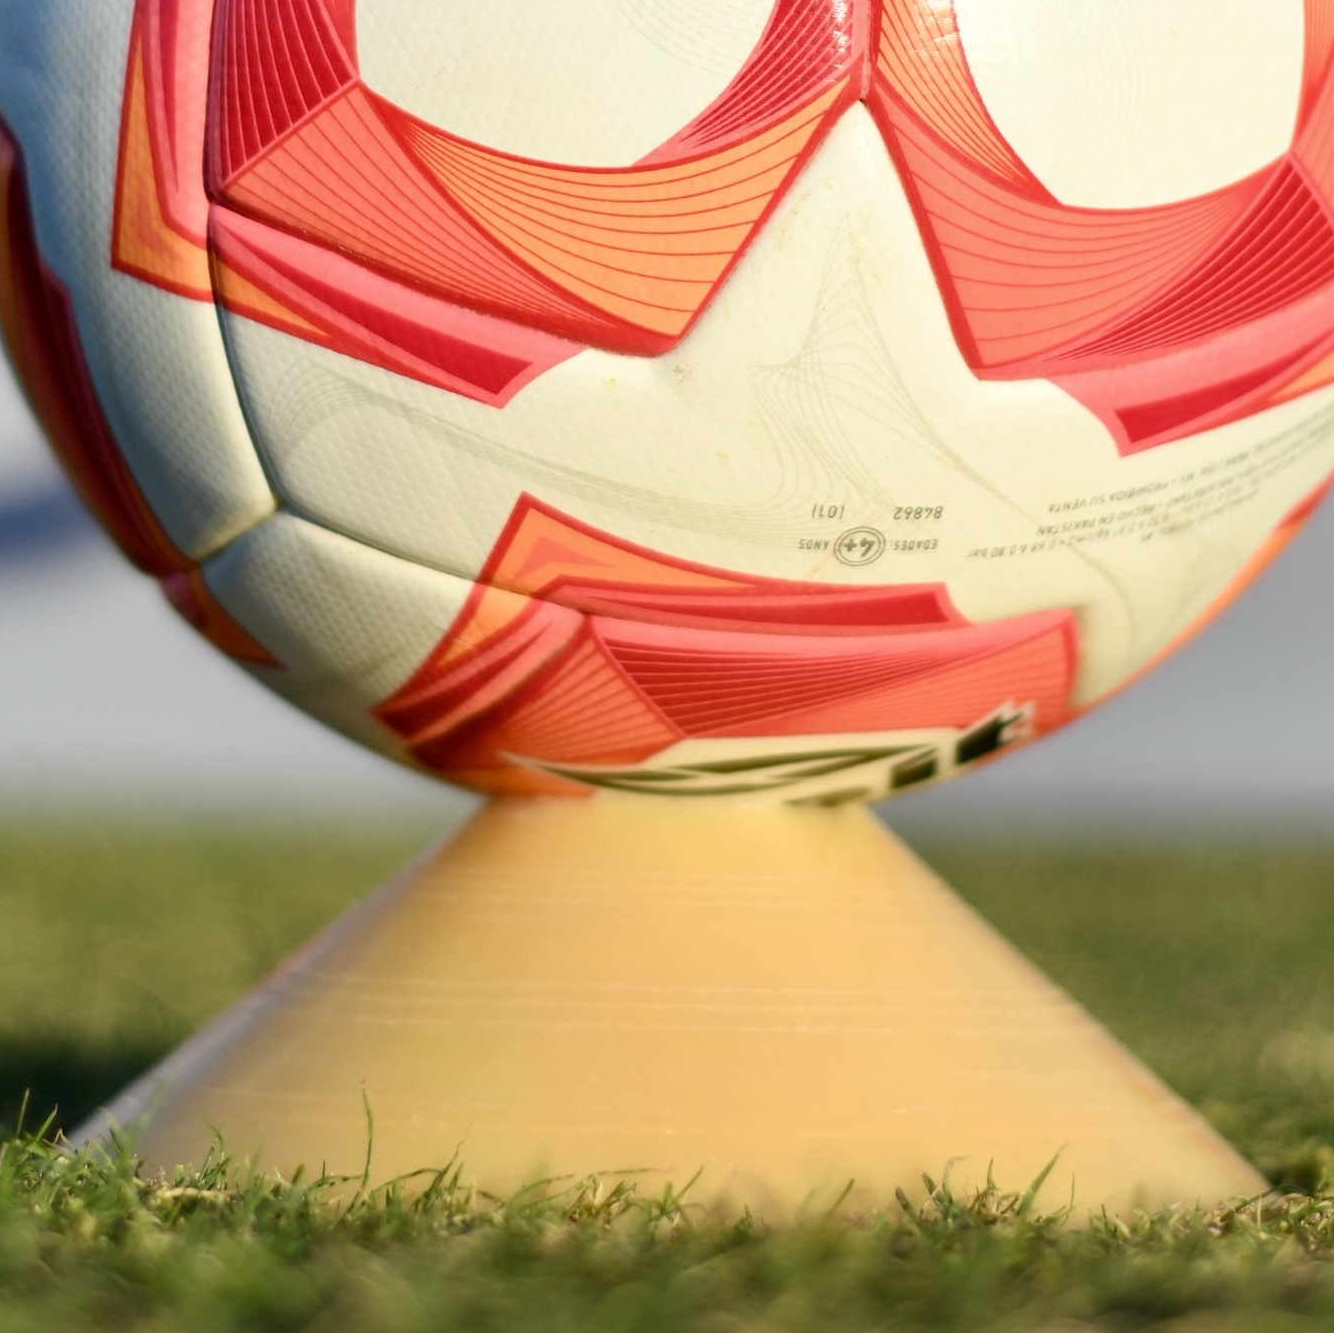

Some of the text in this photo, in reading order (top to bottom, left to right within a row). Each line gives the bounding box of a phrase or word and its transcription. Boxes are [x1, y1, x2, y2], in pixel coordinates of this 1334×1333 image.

[1048, 498, 1086, 513] VENTA
[893, 506, 943, 520] 84862
[1099, 512, 1115, 526] EN
[1037, 518, 1096, 536] PAKISTAN
[844, 537, 875, 557] 4+
[967, 547, 988, 558] bar
